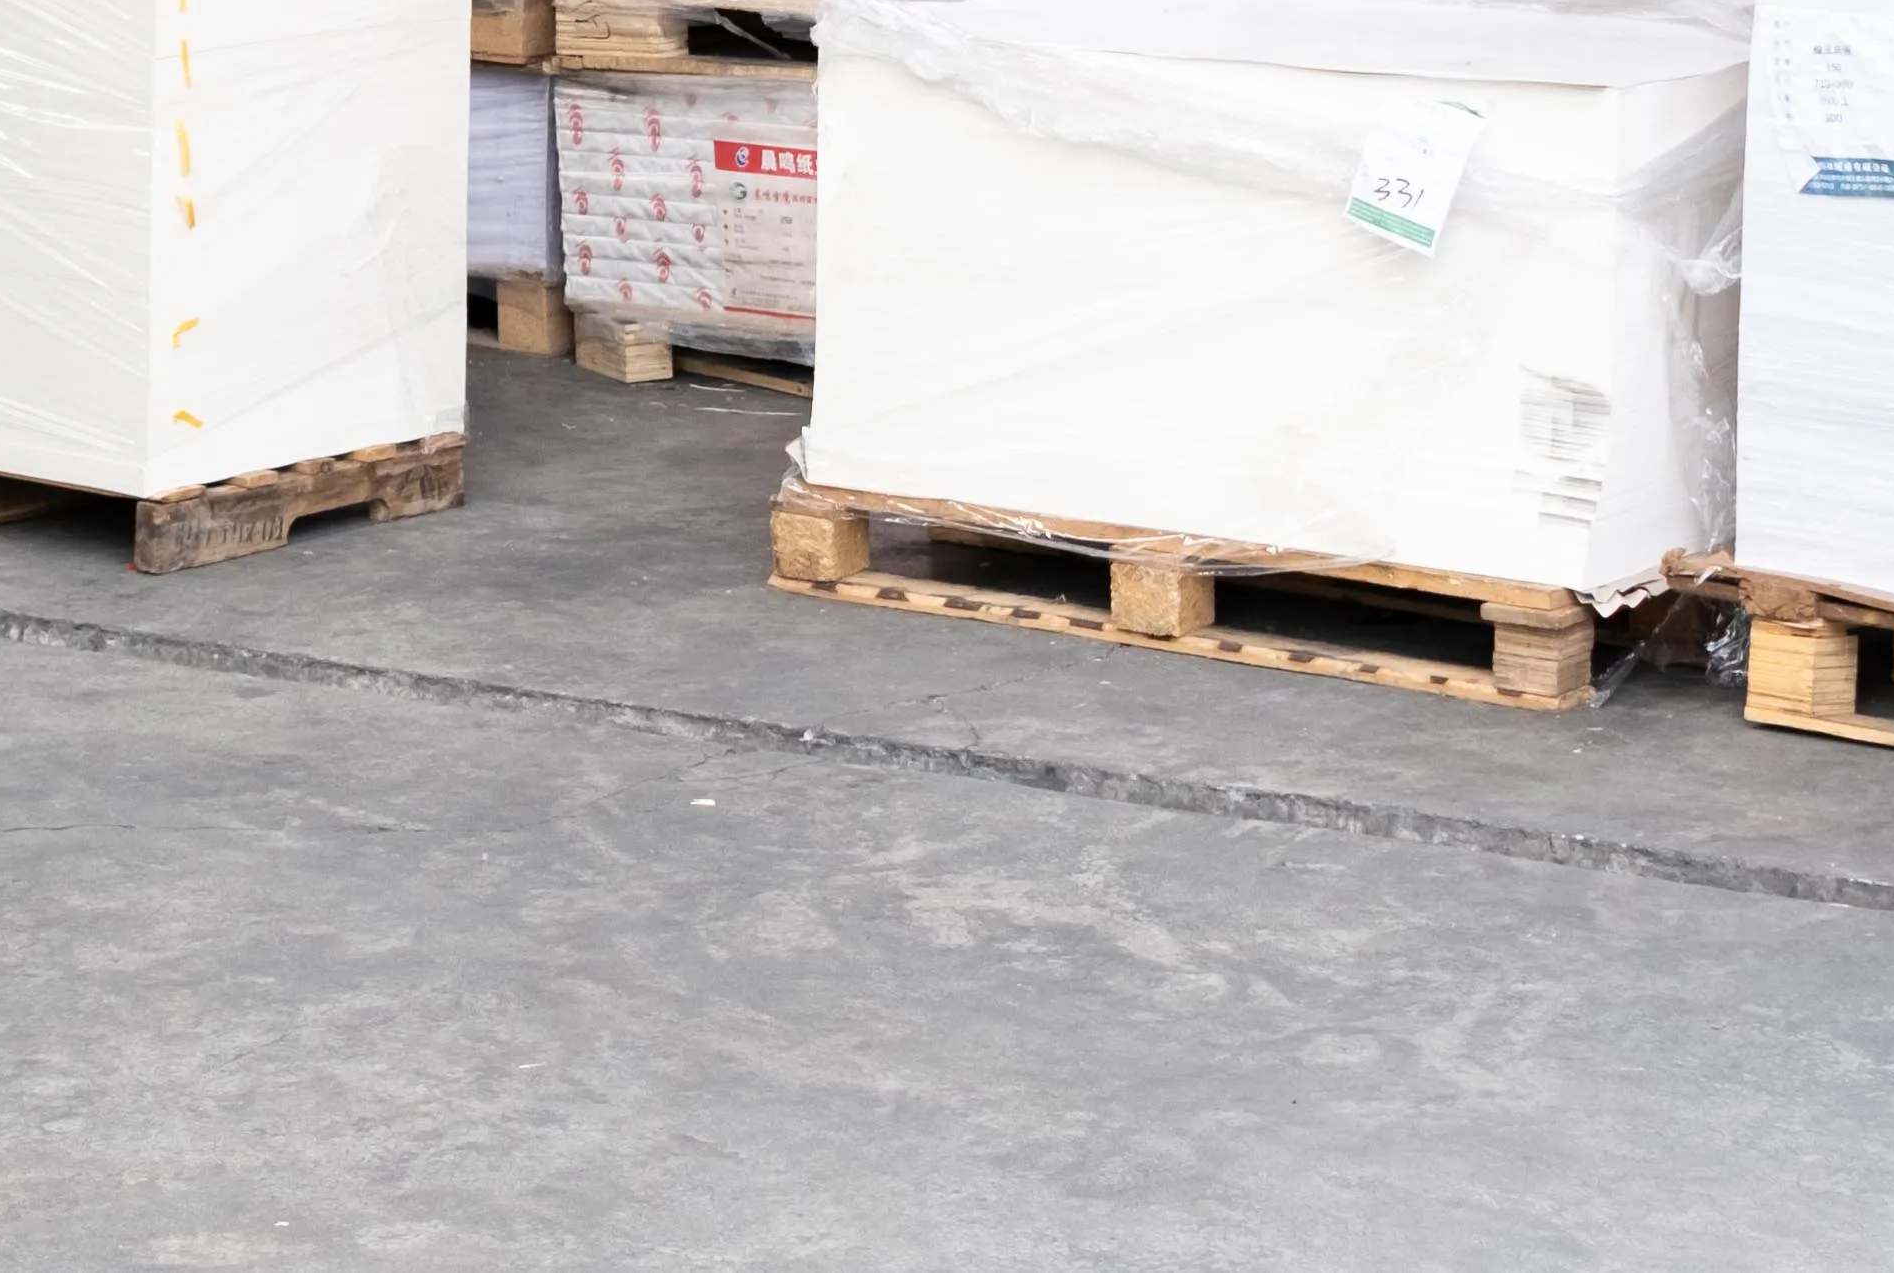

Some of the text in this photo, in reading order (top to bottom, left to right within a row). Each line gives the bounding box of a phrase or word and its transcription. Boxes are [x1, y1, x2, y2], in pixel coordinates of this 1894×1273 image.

[760, 148, 818, 179] 晨鸣纸
[1373, 177, 1425, 209] 331
